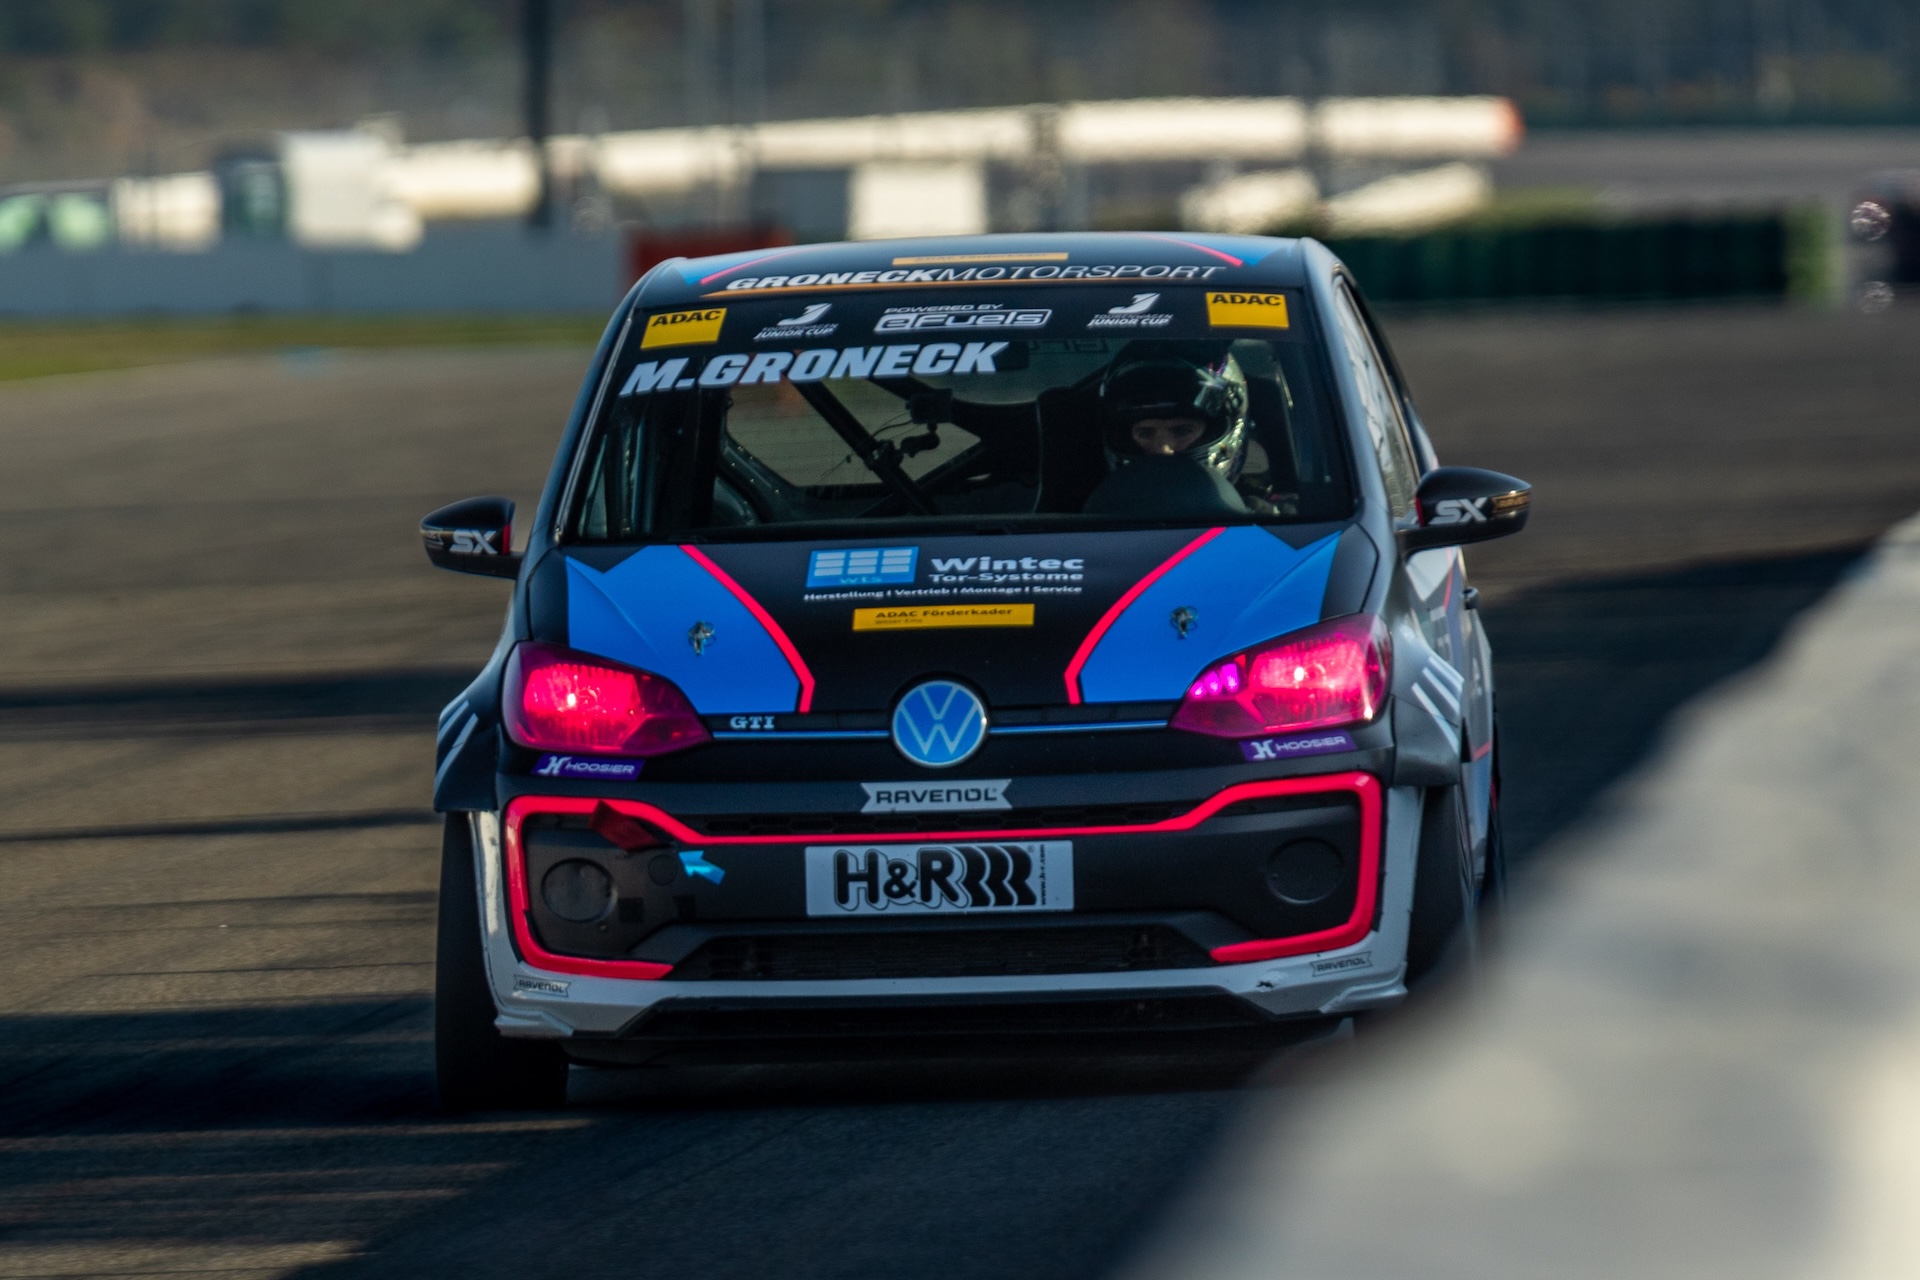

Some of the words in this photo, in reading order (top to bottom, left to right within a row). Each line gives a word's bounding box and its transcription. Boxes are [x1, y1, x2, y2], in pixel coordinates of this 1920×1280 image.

[1211, 293, 1282, 307] ADAC
[884, 304, 973, 314] POWERED
[976, 303, 1004, 311] BY
[650, 309, 722, 328] ADAC
[1086, 318, 1139, 329] JUNIOR
[1140, 318, 1171, 326] CUP
[753, 330, 804, 340] JUNIOR
[805, 327, 836, 336] CUP
[619, 341, 1009, 398] M.GRONECK
[1428, 497, 1488, 525] SX
[449, 528, 498, 555] SX
[930, 556, 1085, 572] Wintec
[928, 572, 1084, 583] Tor-Systeme
[803, 590, 885, 602] Herstellung
[894, 587, 950, 597] Vertrieb
[960, 585, 1022, 595] Montage
[1032, 585, 1083, 594] Service
[875, 610, 917, 619] ADAC
[922, 608, 1013, 617] Förderkader
[730, 716, 775, 729] GTI
[1275, 735, 1346, 751] HOOSIER
[565, 760, 635, 774] HOOSIER
[875, 788, 998, 805] RAVENOL
[833, 848, 972, 912] H&R
[1317, 958, 1366, 972] RAVENOL
[518, 979, 564, 993] RAVENOL
